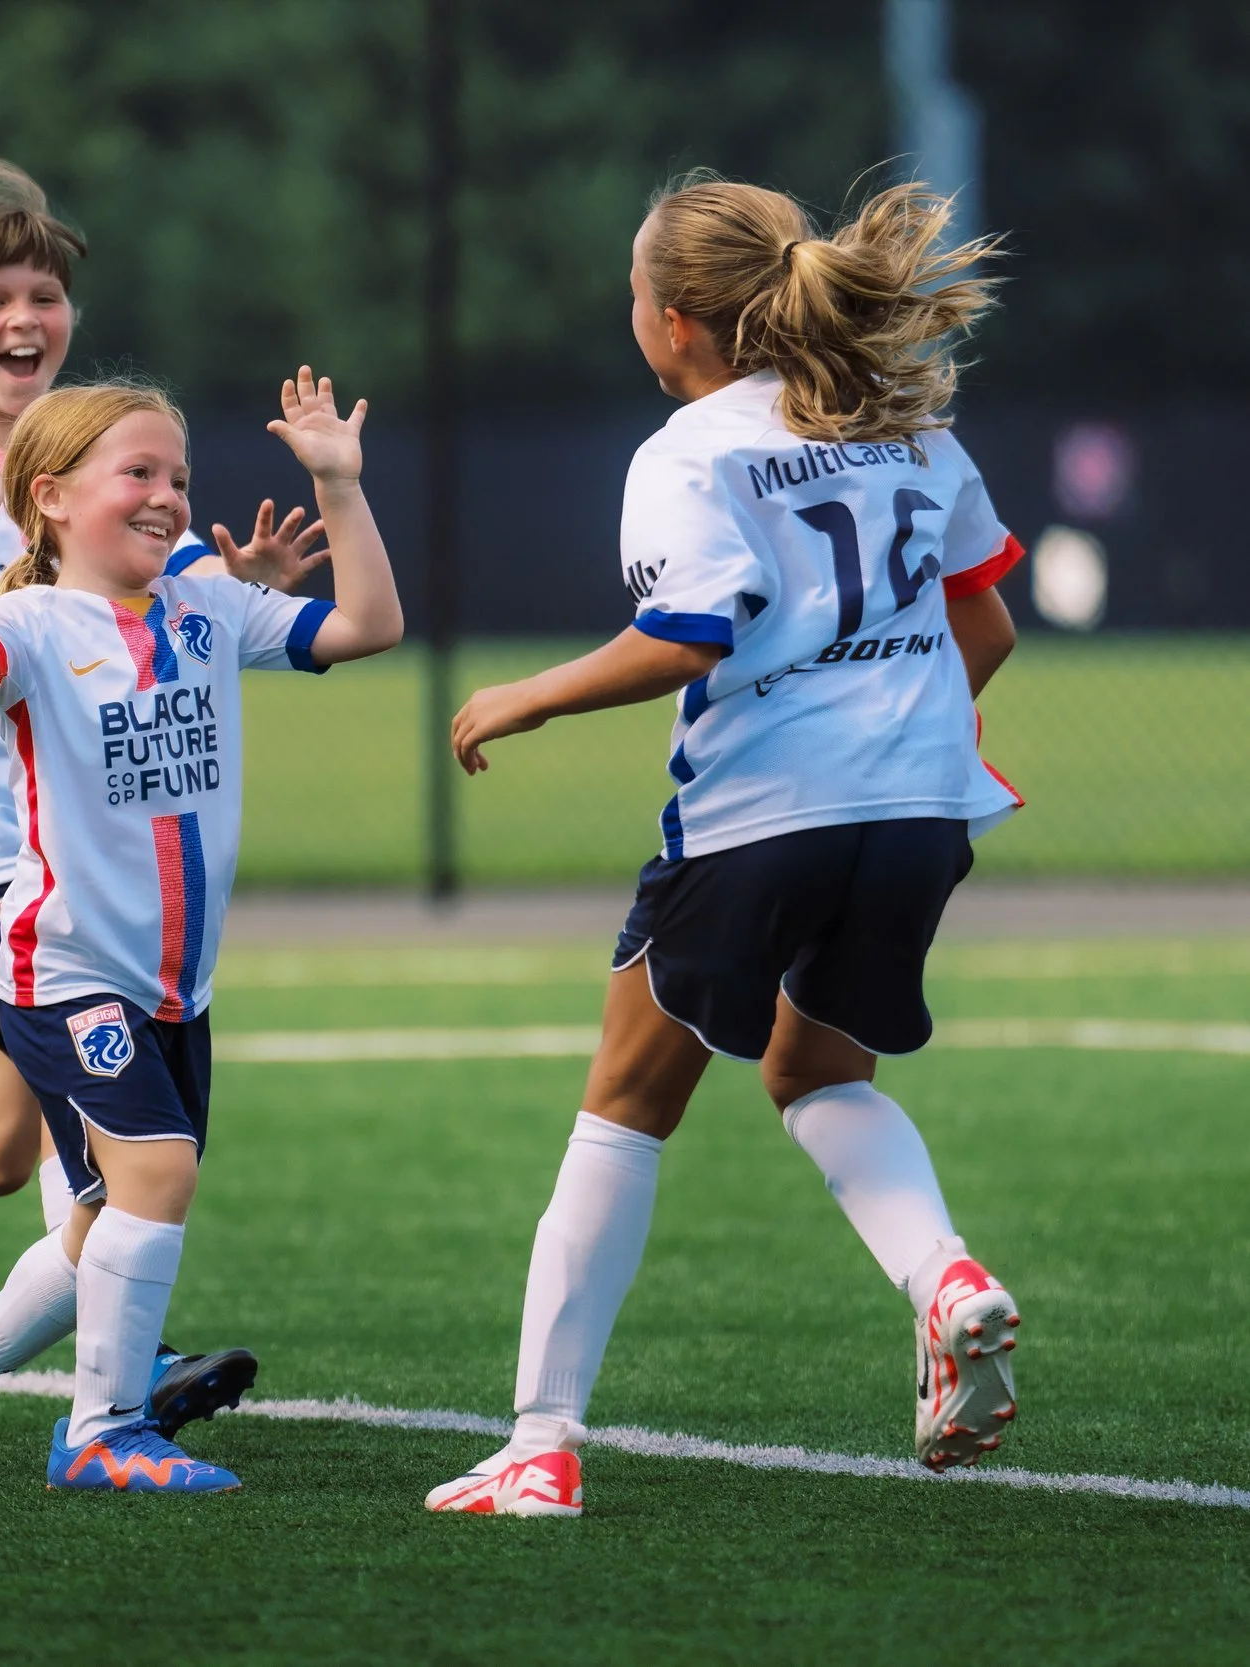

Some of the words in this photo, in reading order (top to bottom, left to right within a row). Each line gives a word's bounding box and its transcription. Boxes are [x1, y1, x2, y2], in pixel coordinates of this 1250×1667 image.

[747, 442, 906, 500] MultiCare
[812, 632, 944, 664] BOEIN
[98, 684, 215, 736] BLACK
[103, 723, 218, 769] FUTURE
[139, 758, 220, 801] FUND
[74, 1019, 88, 1031] OL
[87, 1007, 120, 1025] REIGN
